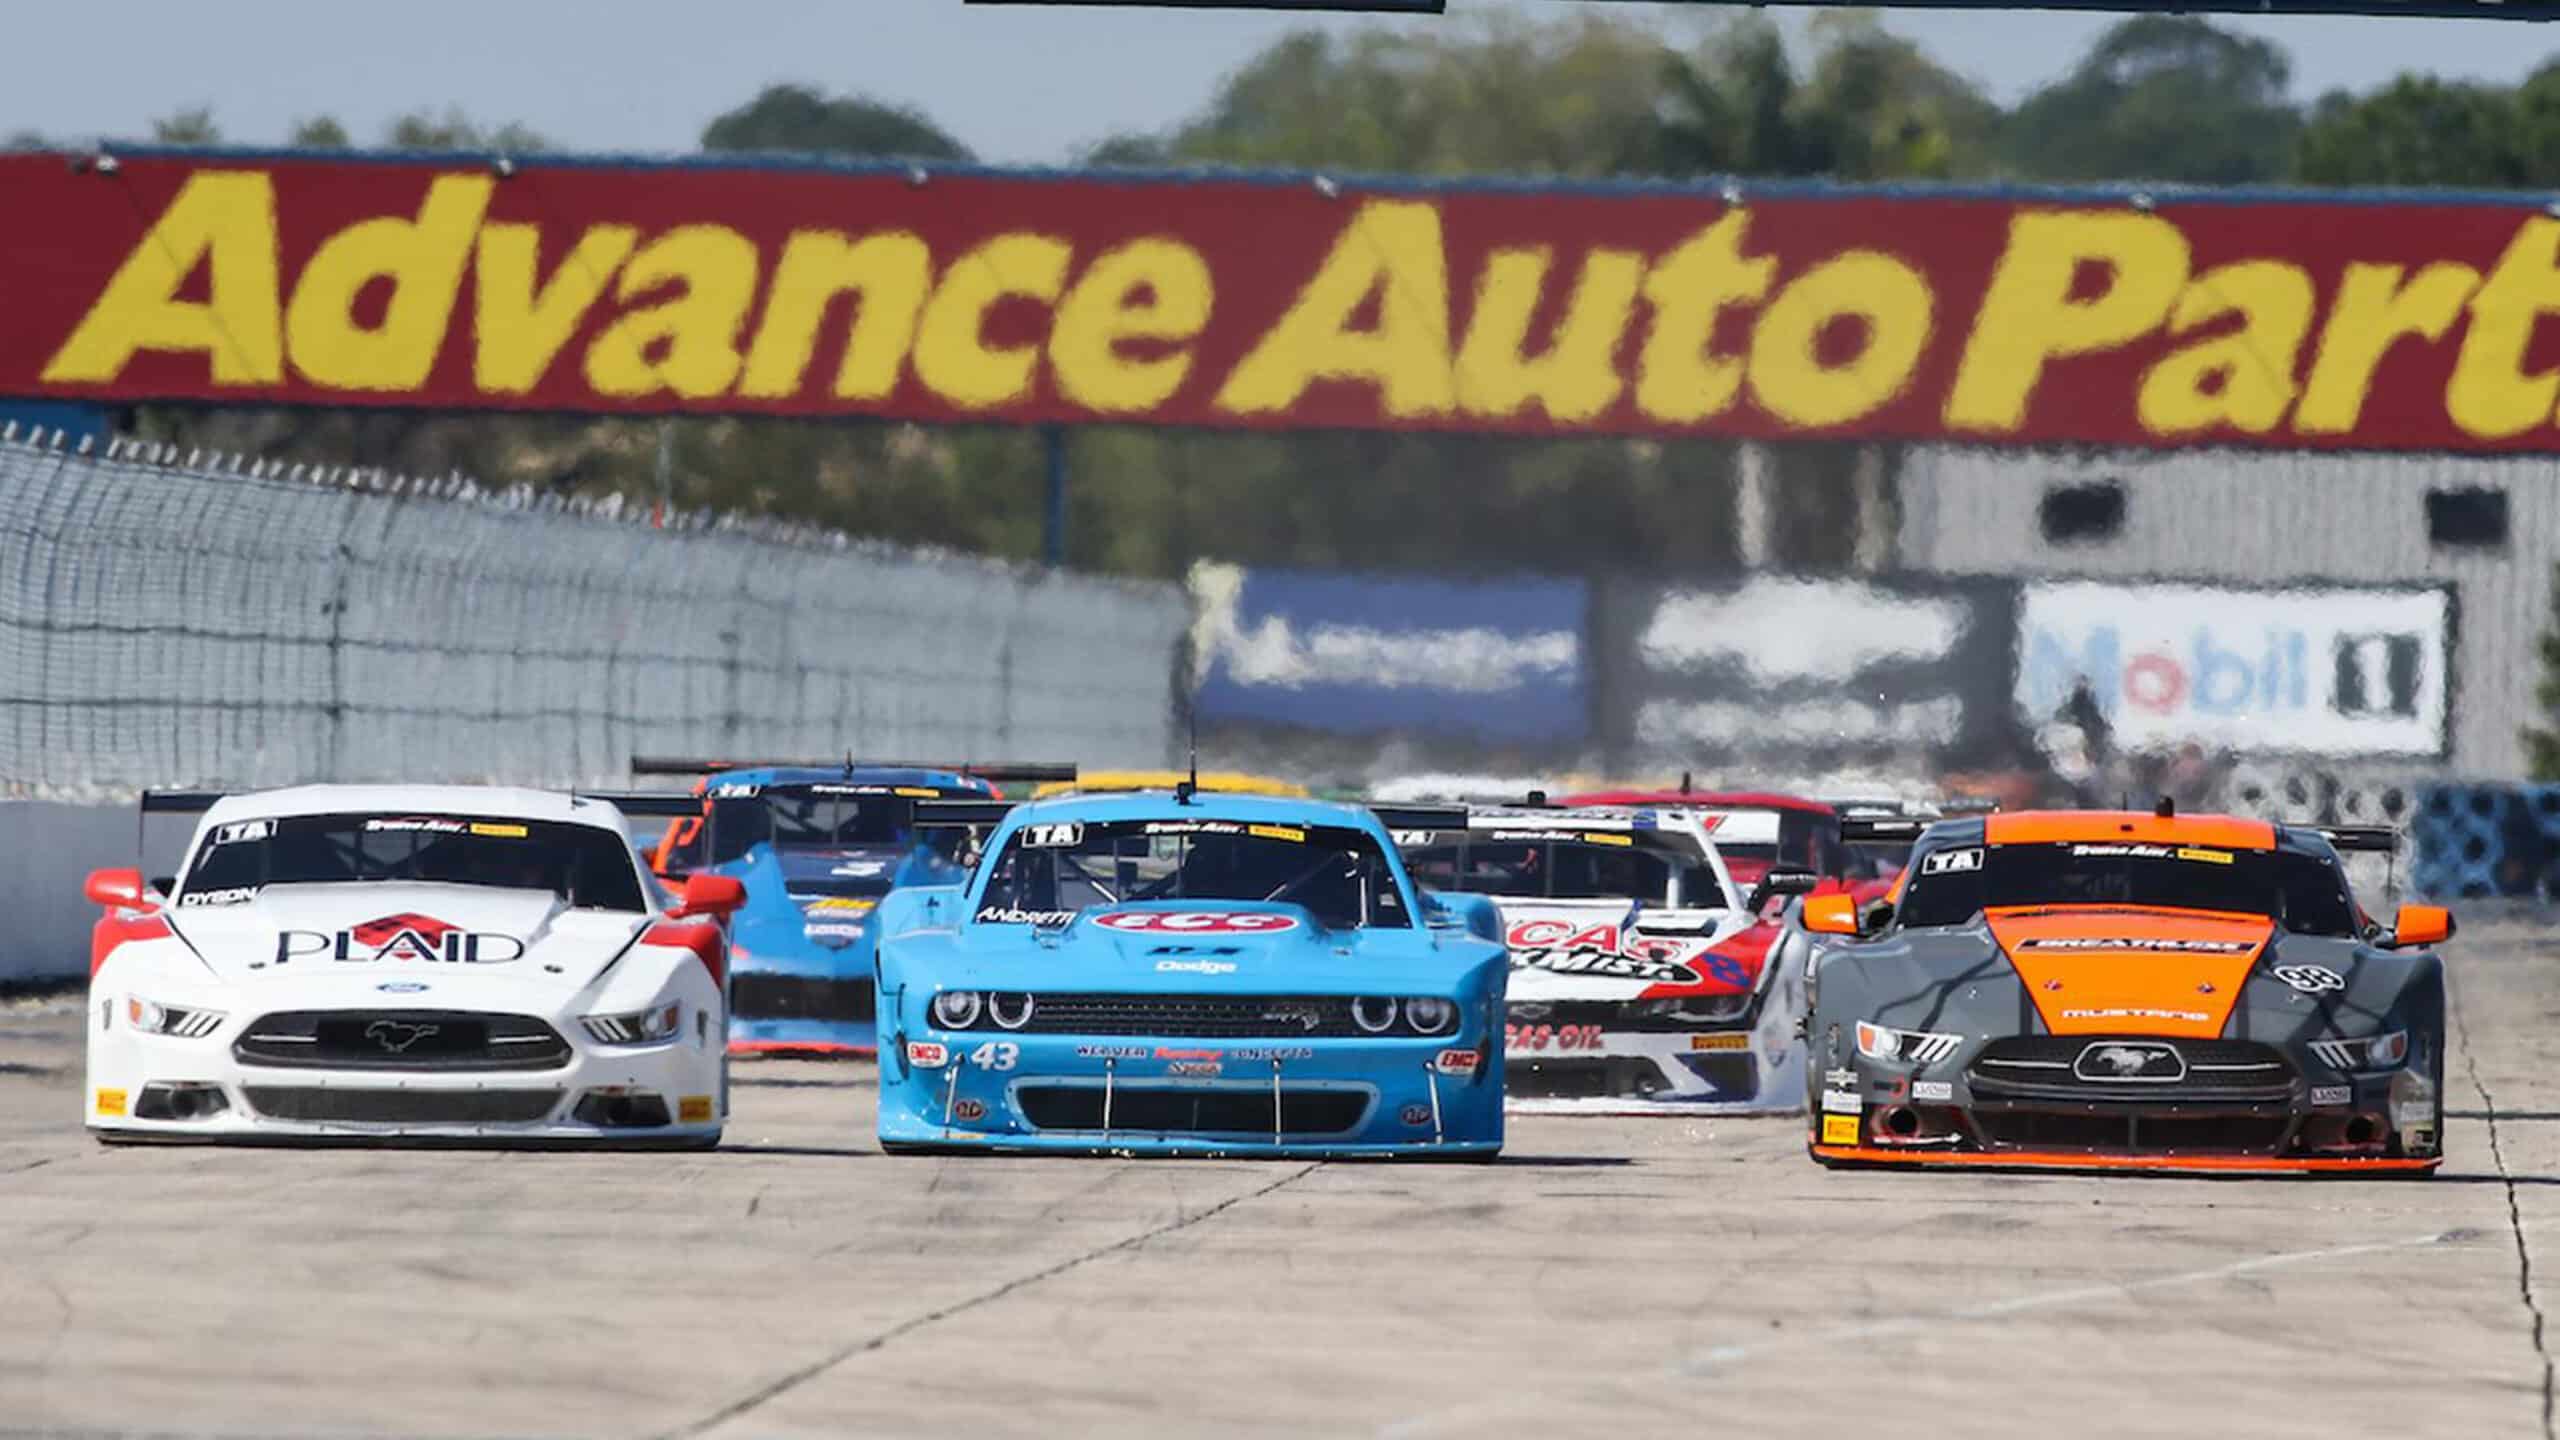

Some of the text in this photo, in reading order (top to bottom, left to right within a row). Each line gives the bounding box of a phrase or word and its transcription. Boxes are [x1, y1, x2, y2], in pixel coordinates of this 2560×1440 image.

[40, 171, 2560, 438] Advance Auto Part
[2032, 625, 2307, 715] Mobil
[1033, 825, 1074, 843] TA
[1935, 853, 1974, 869] TA
[2072, 845, 2128, 855] Trans
[276, 930, 525, 964] PLAID
[1507, 920, 1680, 960] CAS
[1156, 960, 1237, 975] Dodge
[970, 1041, 1020, 1071] 43
